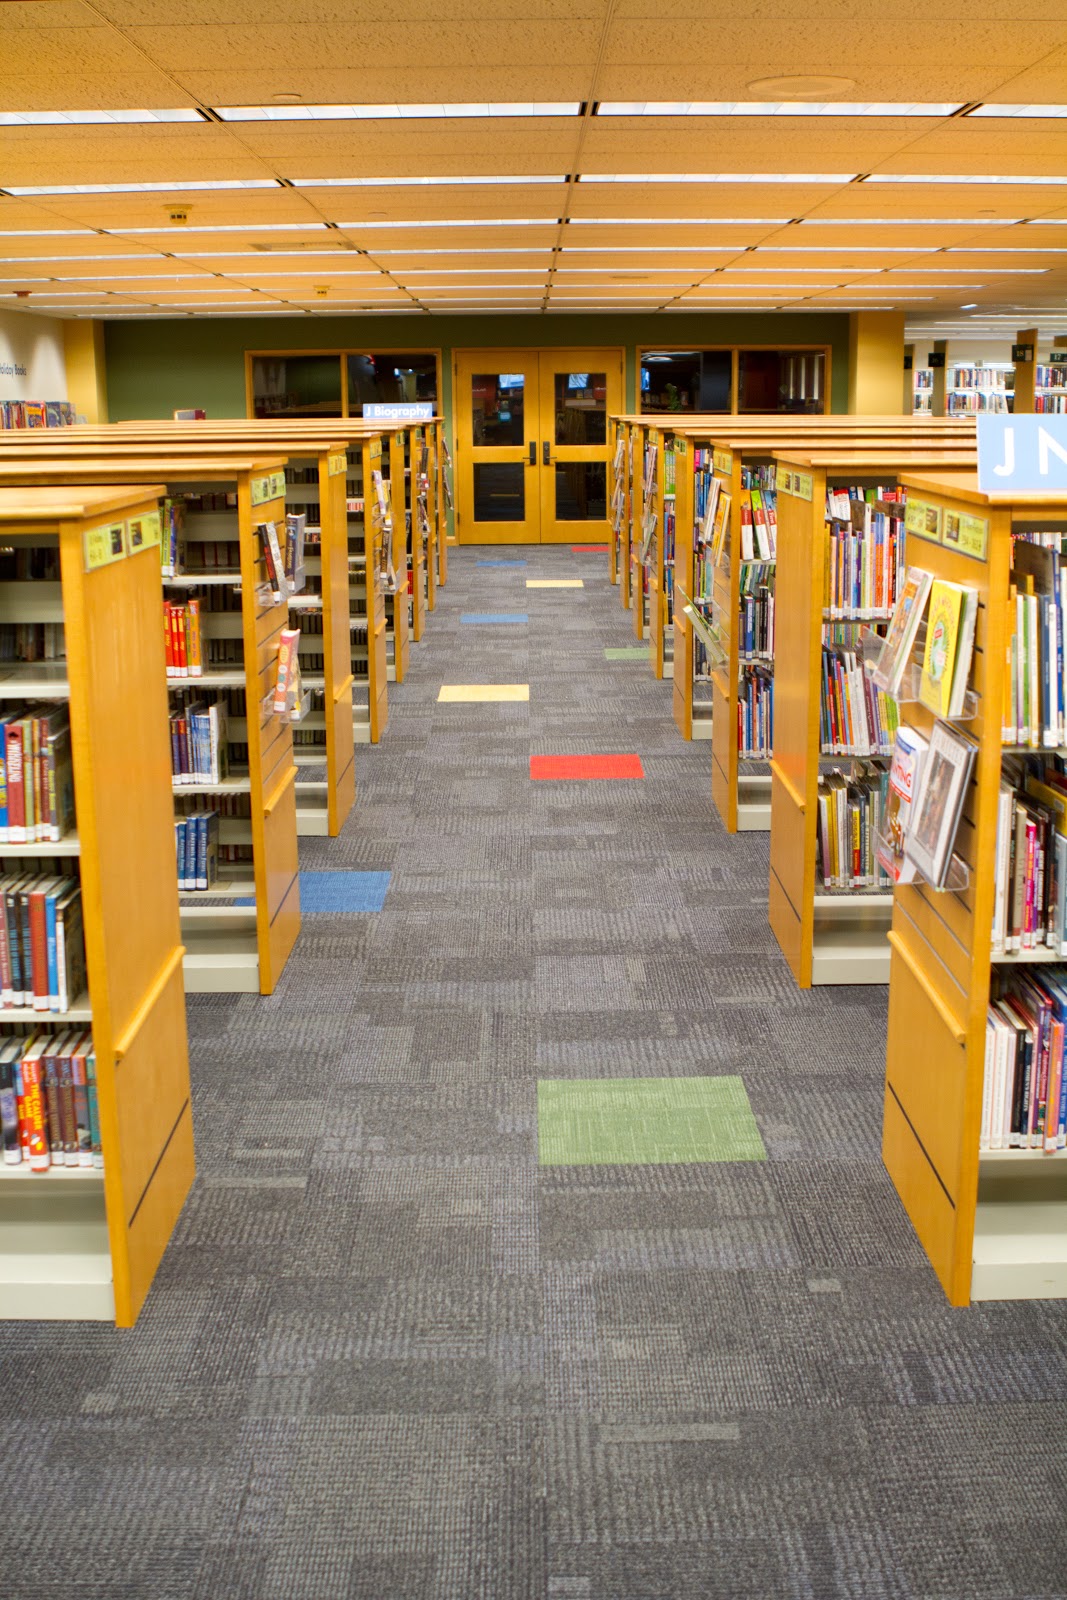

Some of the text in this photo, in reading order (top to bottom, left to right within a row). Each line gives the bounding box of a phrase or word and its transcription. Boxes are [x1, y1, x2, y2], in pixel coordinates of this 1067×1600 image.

[365, 405, 430, 419] J Biography
[992, 426, 1015, 476] J
[24, 1095, 33, 1118] GAME
[31, 1083, 43, 1130] THE CALDER
